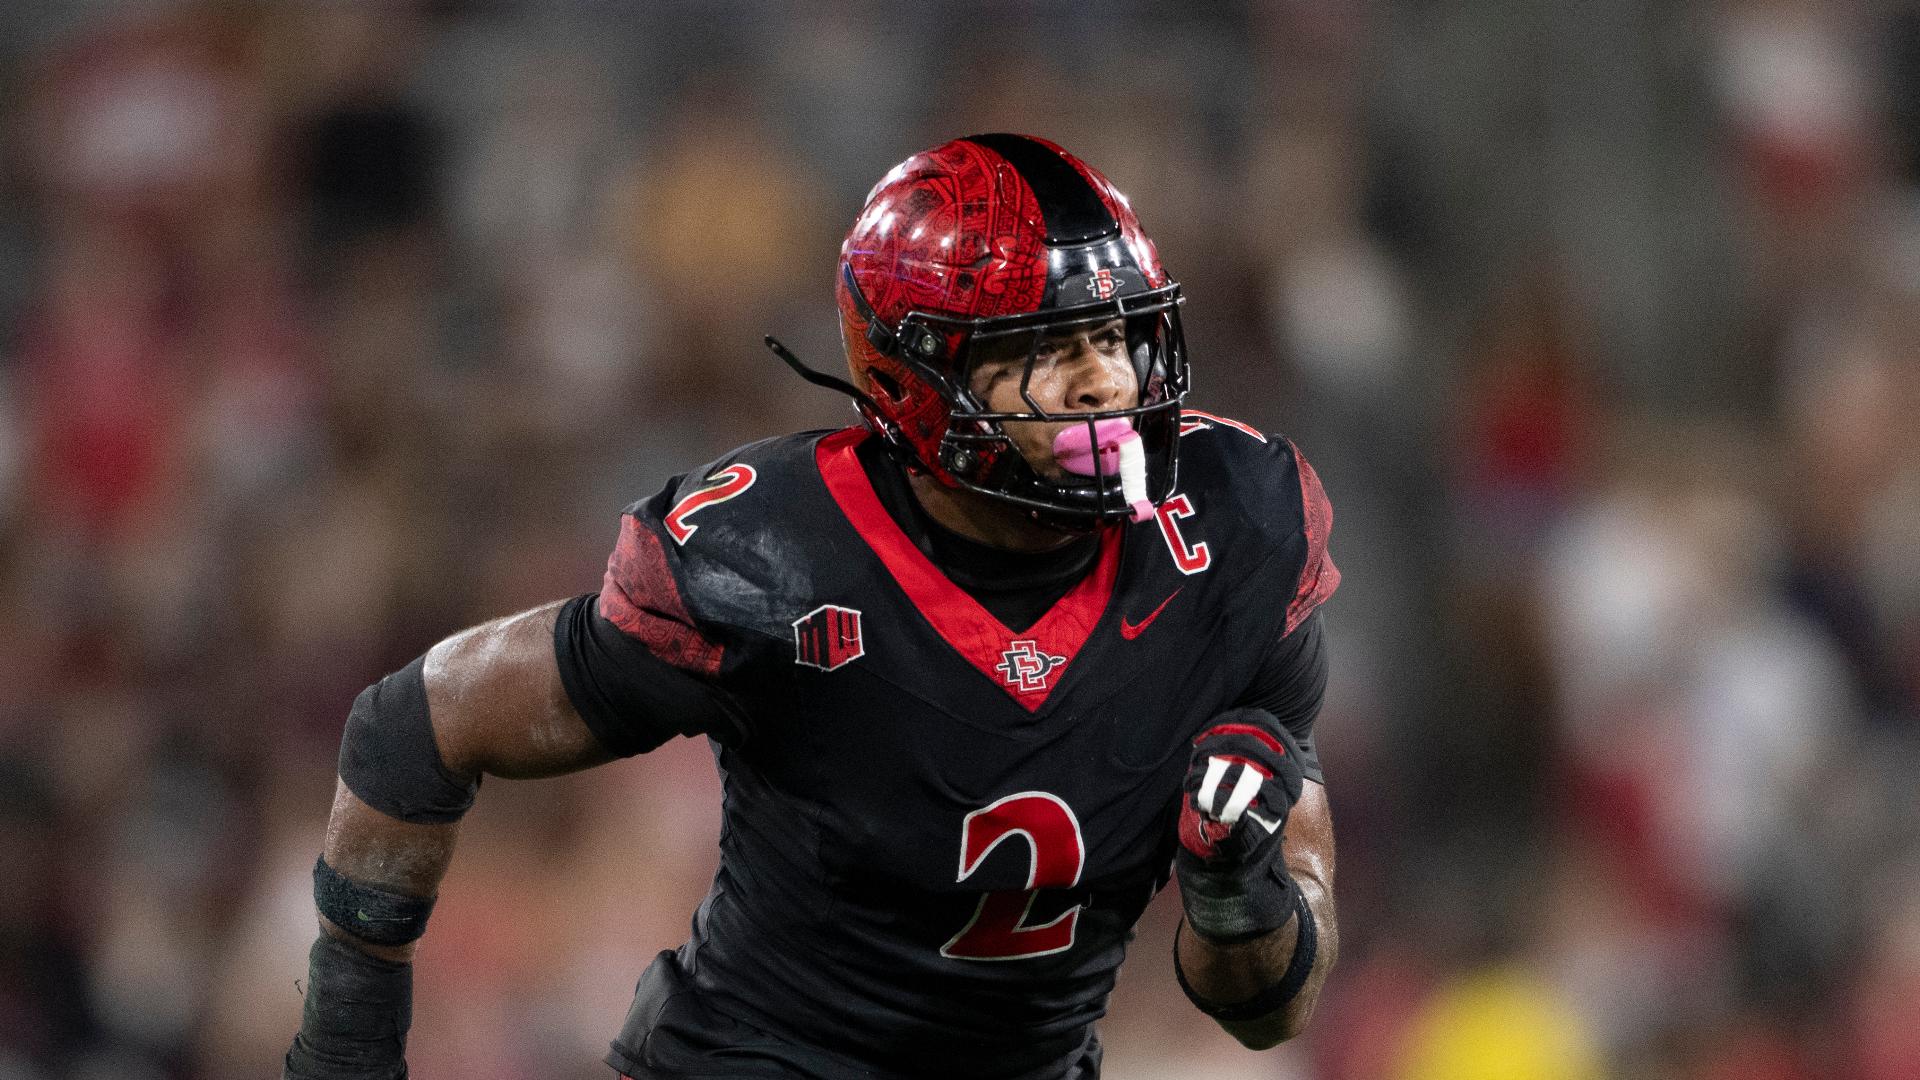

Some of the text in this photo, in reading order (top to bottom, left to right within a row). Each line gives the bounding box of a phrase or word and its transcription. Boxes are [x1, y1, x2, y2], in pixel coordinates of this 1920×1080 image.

[663, 463, 757, 546] 2
[1154, 493, 1211, 576] C
[940, 791, 1085, 961] 2
